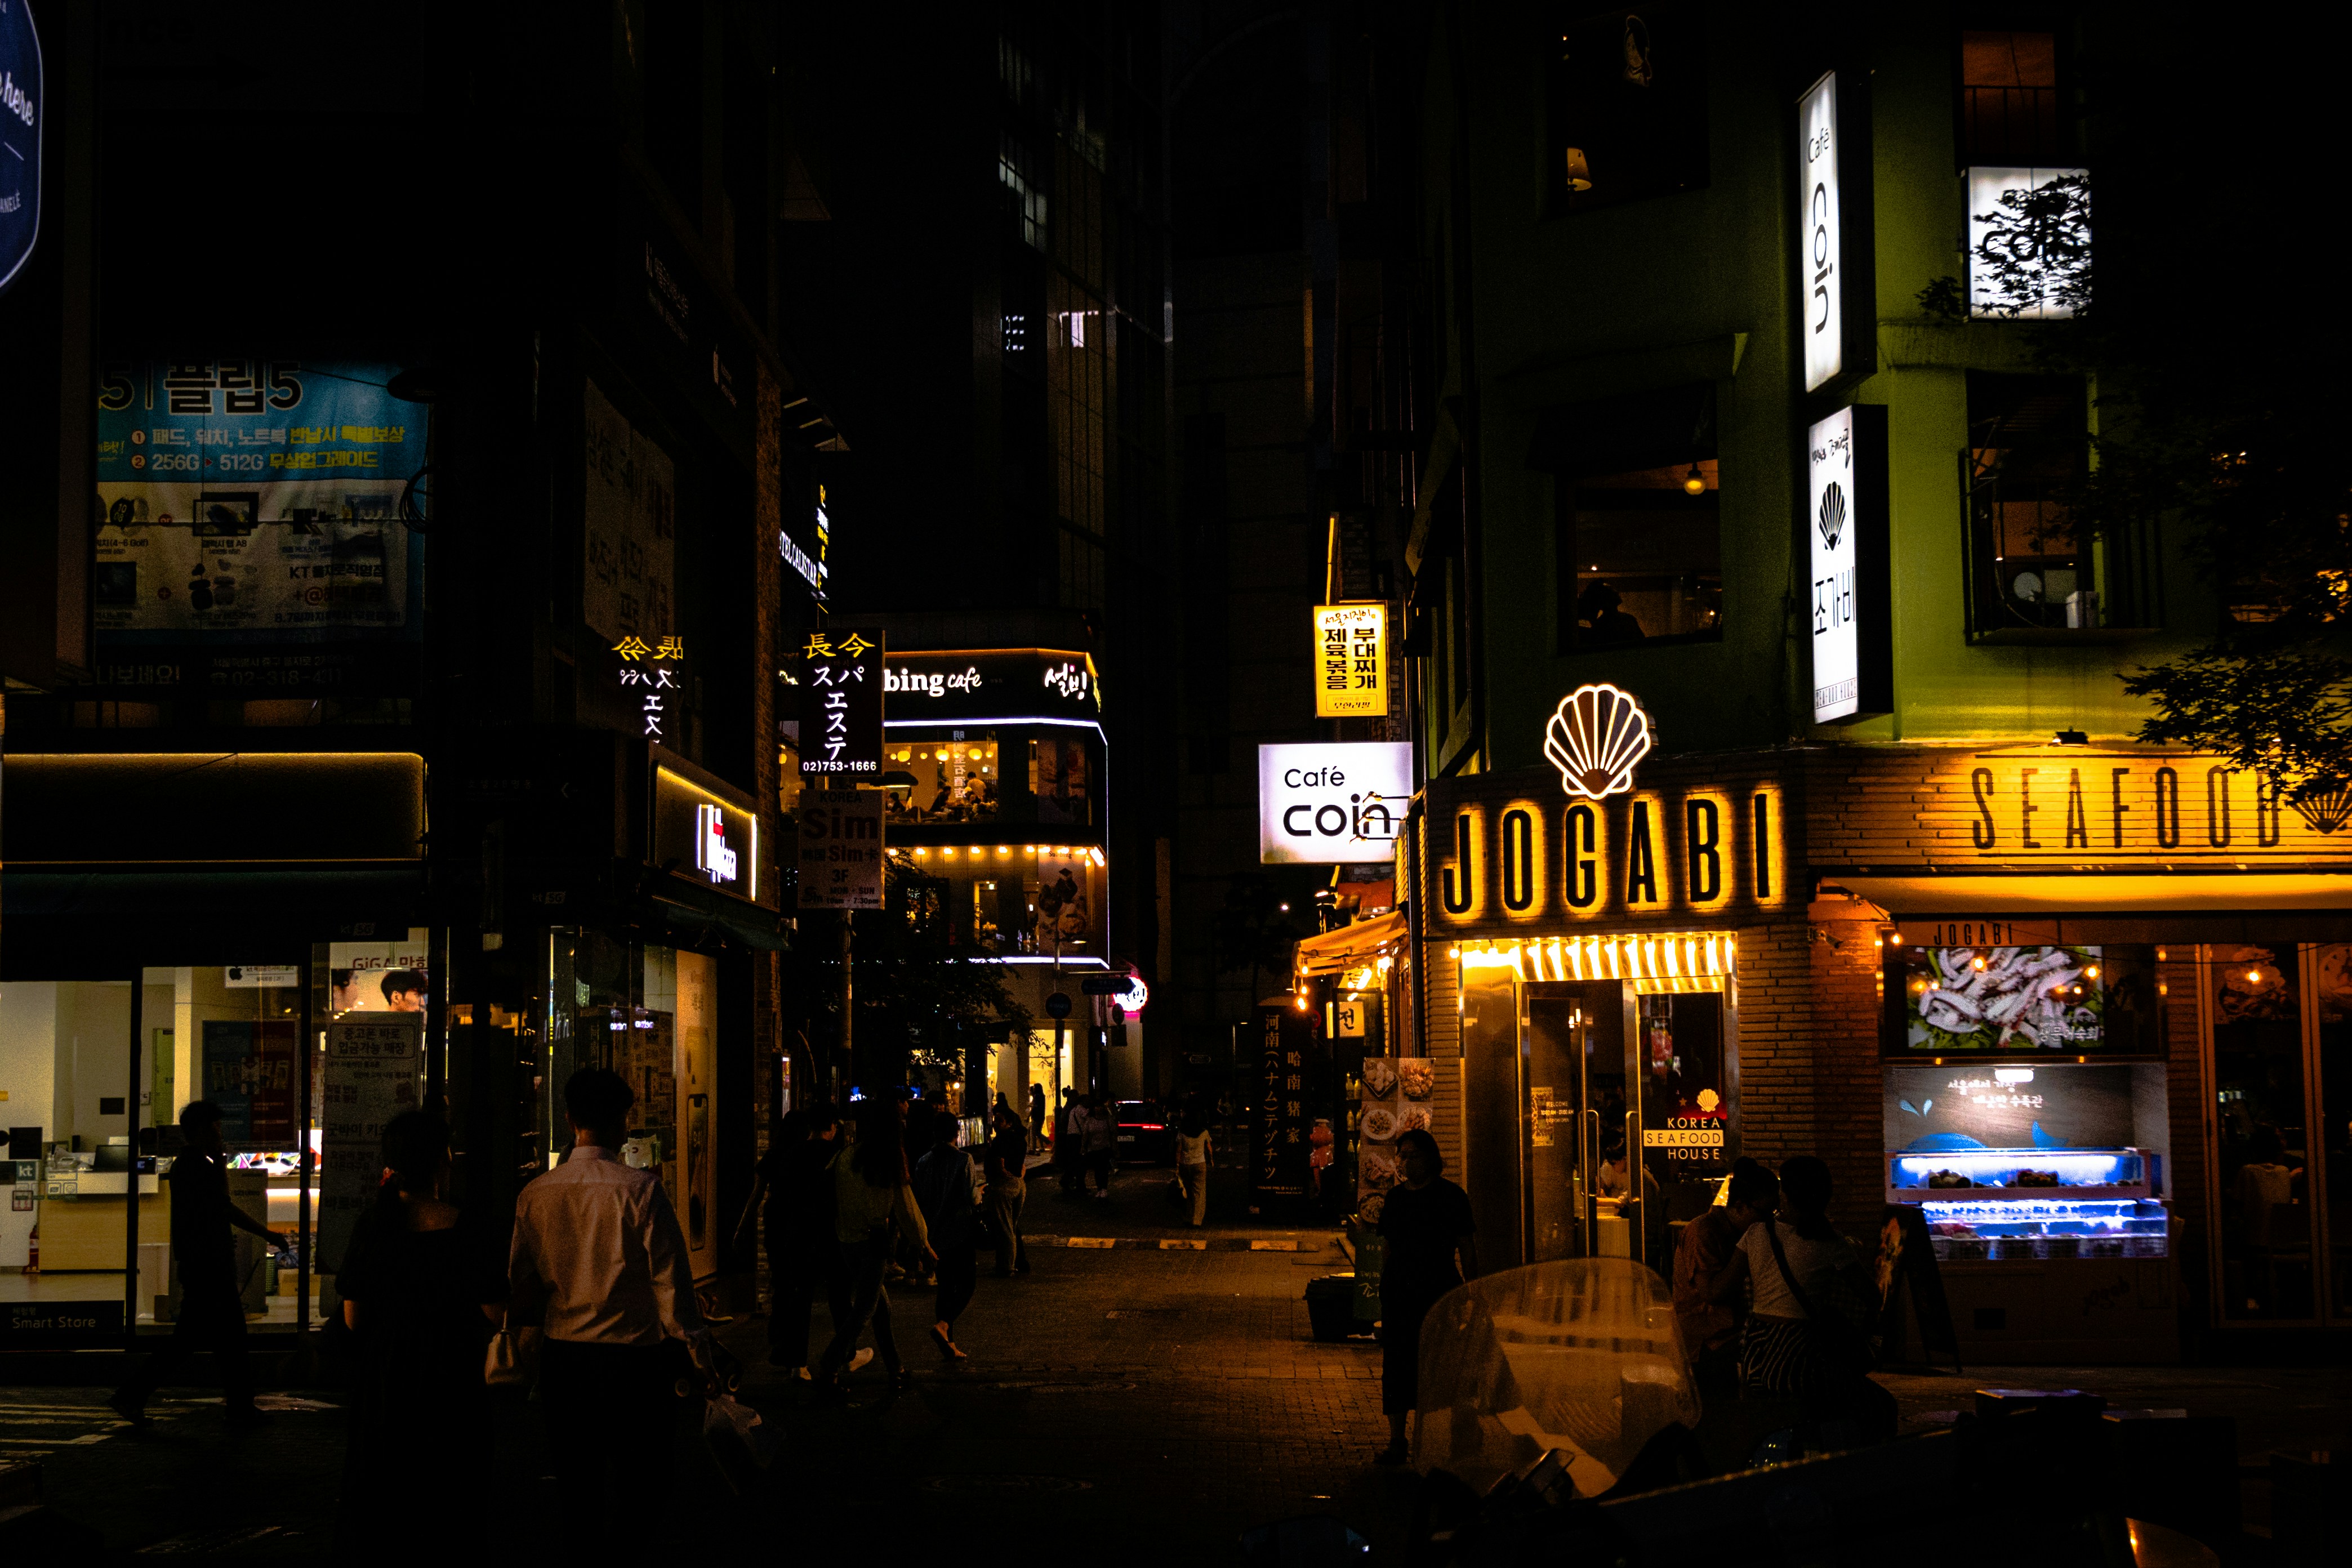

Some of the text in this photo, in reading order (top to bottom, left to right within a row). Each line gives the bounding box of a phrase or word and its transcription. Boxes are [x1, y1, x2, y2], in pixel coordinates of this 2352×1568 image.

[1807, 127, 1830, 163] Café
[1812, 181, 1833, 335] coin
[164, 360, 304, 416] 플립5
[238, 428, 287, 445] 노트북
[289, 426, 336, 444] 반납시
[152, 453, 199, 471] 256G
[220, 453, 264, 471] 512G
[269, 451, 378, 470] 무상업그레이드
[290, 567, 310, 579] KT
[802, 632, 876, 660] 長今
[1325, 629, 1348, 690] 제육볶음
[1353, 627, 1377, 689] 부대찌개
[883, 667, 982, 697] bing cafe
[1043, 663, 1088, 700] 설빙
[803, 761, 877, 772] 02)753-1666
[1284, 766, 1345, 789] Café
[819, 790, 862, 803] KOREA
[1971, 765, 2280, 848] SEAFOOD
[803, 808, 878, 840] Sim
[1283, 793, 1391, 837] coin
[828, 845, 863, 863] Sim
[1443, 793, 1771, 915] JOGABI
[831, 868, 849, 883] 3F
[1933, 924, 2014, 946] JOGABI
[1339, 1008, 1355, 1030] 전
[344, 1027, 400, 1040] 중고폰 바로
[338, 1041, 406, 1055] 입금가능 매장
[1667, 1117, 1721, 1129] KOREA
[1646, 1133, 1721, 1144] SEAFOOD
[1668, 1148, 1721, 1160] HOUSE
[19, 1165, 33, 1177] kt
[11, 1316, 97, 1330] Smart Store
